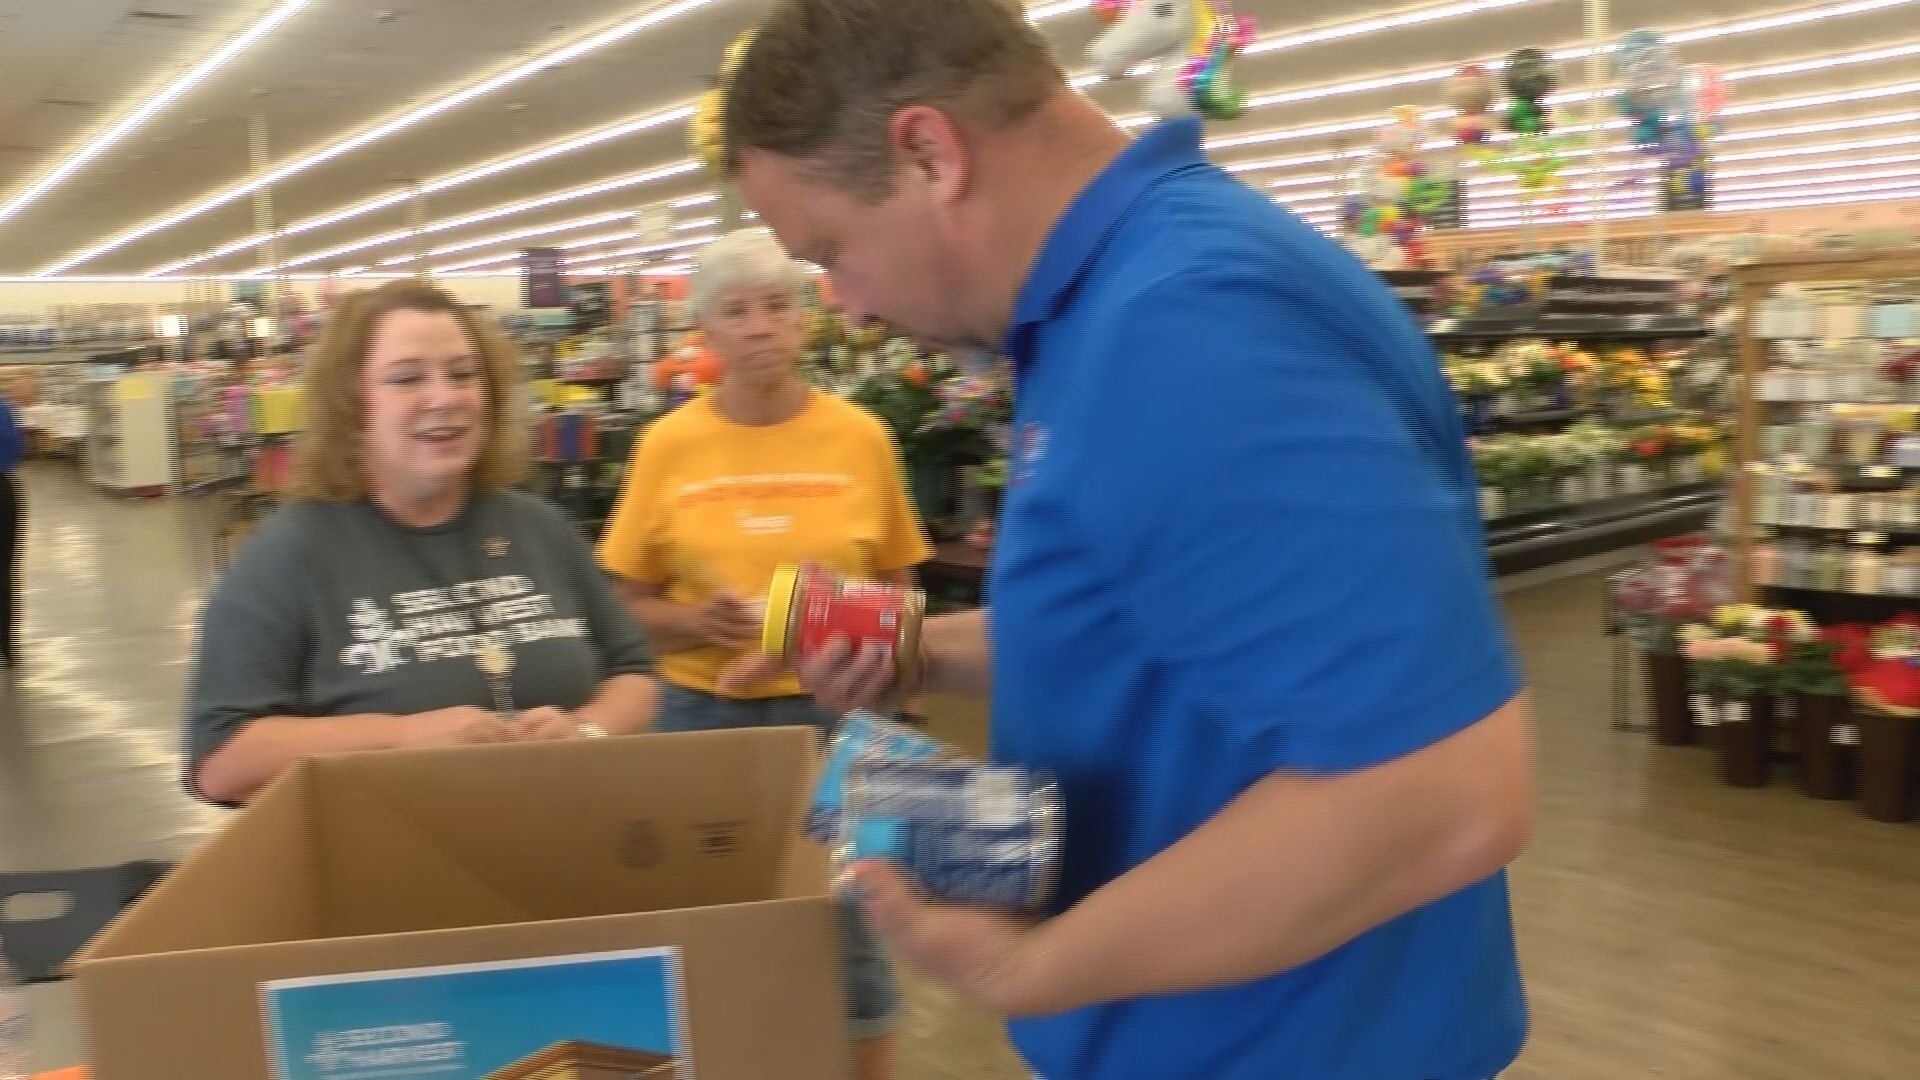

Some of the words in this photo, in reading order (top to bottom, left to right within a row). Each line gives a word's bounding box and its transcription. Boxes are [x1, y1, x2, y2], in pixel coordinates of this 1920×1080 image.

[391, 575, 535, 613] SECOND
[413, 630, 516, 662] FOOD
[509, 618, 592, 644] BANK
